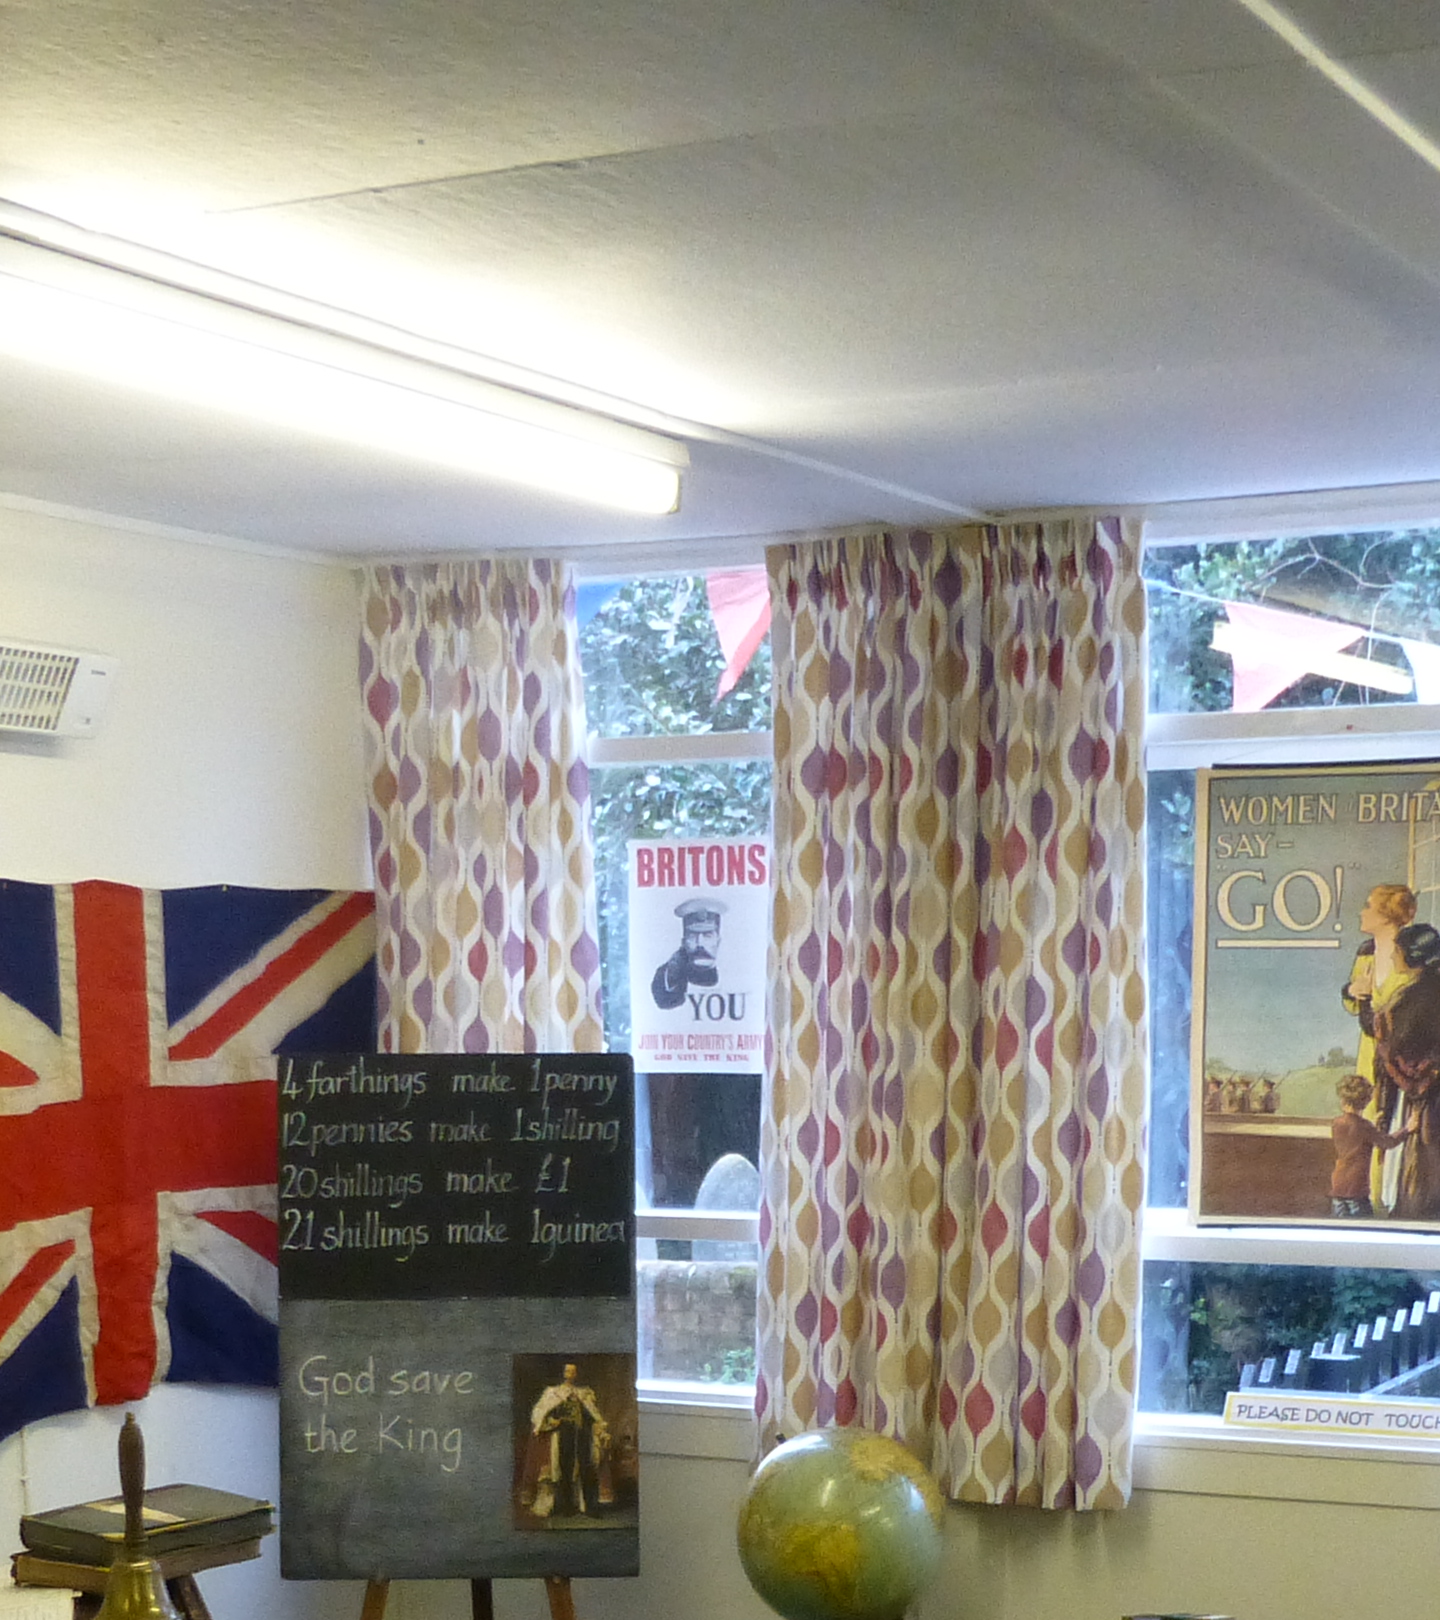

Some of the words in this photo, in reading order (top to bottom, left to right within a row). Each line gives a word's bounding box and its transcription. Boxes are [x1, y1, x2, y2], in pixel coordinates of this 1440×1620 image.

[1217, 793, 1337, 825] WOMEN
[636, 843, 766, 888] BRITONS
[686, 993, 746, 1021] YOU
[661, 1034, 684, 1050] YOUR
[453, 1060, 516, 1093] make
[430, 1111, 491, 1142] make
[446, 1158, 519, 1194] make
[535, 1153, 571, 1193] £1
[448, 1210, 509, 1244] make
[299, 1355, 376, 1396] God
[389, 1367, 475, 1396] save
[1237, 1404, 1300, 1422] PLEASE
[1305, 1408, 1331, 1424] DO
[1335, 1410, 1374, 1426] NOT
[305, 1413, 357, 1453] the
[377, 1413, 464, 1472] King
